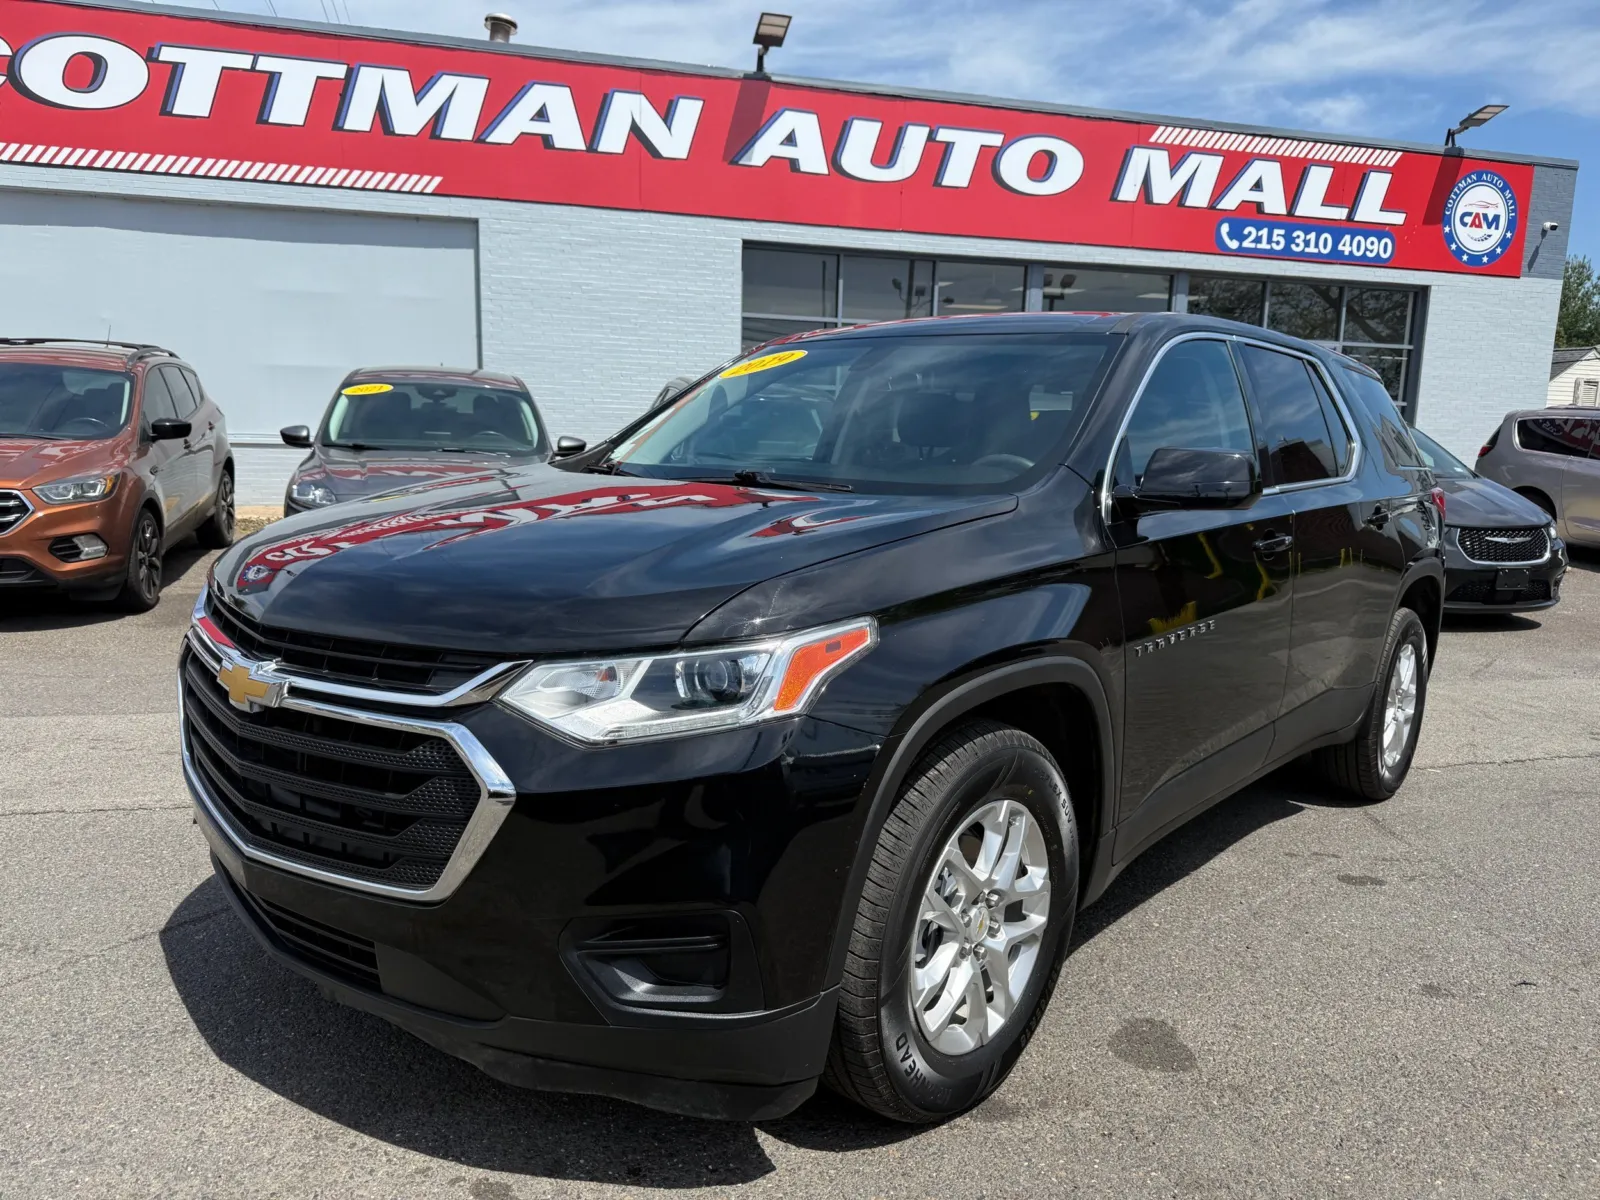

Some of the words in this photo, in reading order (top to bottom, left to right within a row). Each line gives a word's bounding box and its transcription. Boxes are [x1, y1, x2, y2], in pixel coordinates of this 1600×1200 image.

[0, 32, 704, 161] OTTMAN
[728, 107, 1084, 196] AUTO
[1110, 145, 1407, 225] MALL
[1445, 173, 1477, 215] COTTMAN
[1481, 172, 1504, 188] AUTO
[1504, 189, 1516, 219] MALL
[1459, 211, 1501, 231] CAM
[1242, 226, 1286, 251] 215
[1290, 230, 1333, 255] 310
[1338, 234, 1393, 259] 4090
[1134, 619, 1216, 658] TRAVERSE
[1061, 798, 1073, 824] SUV
